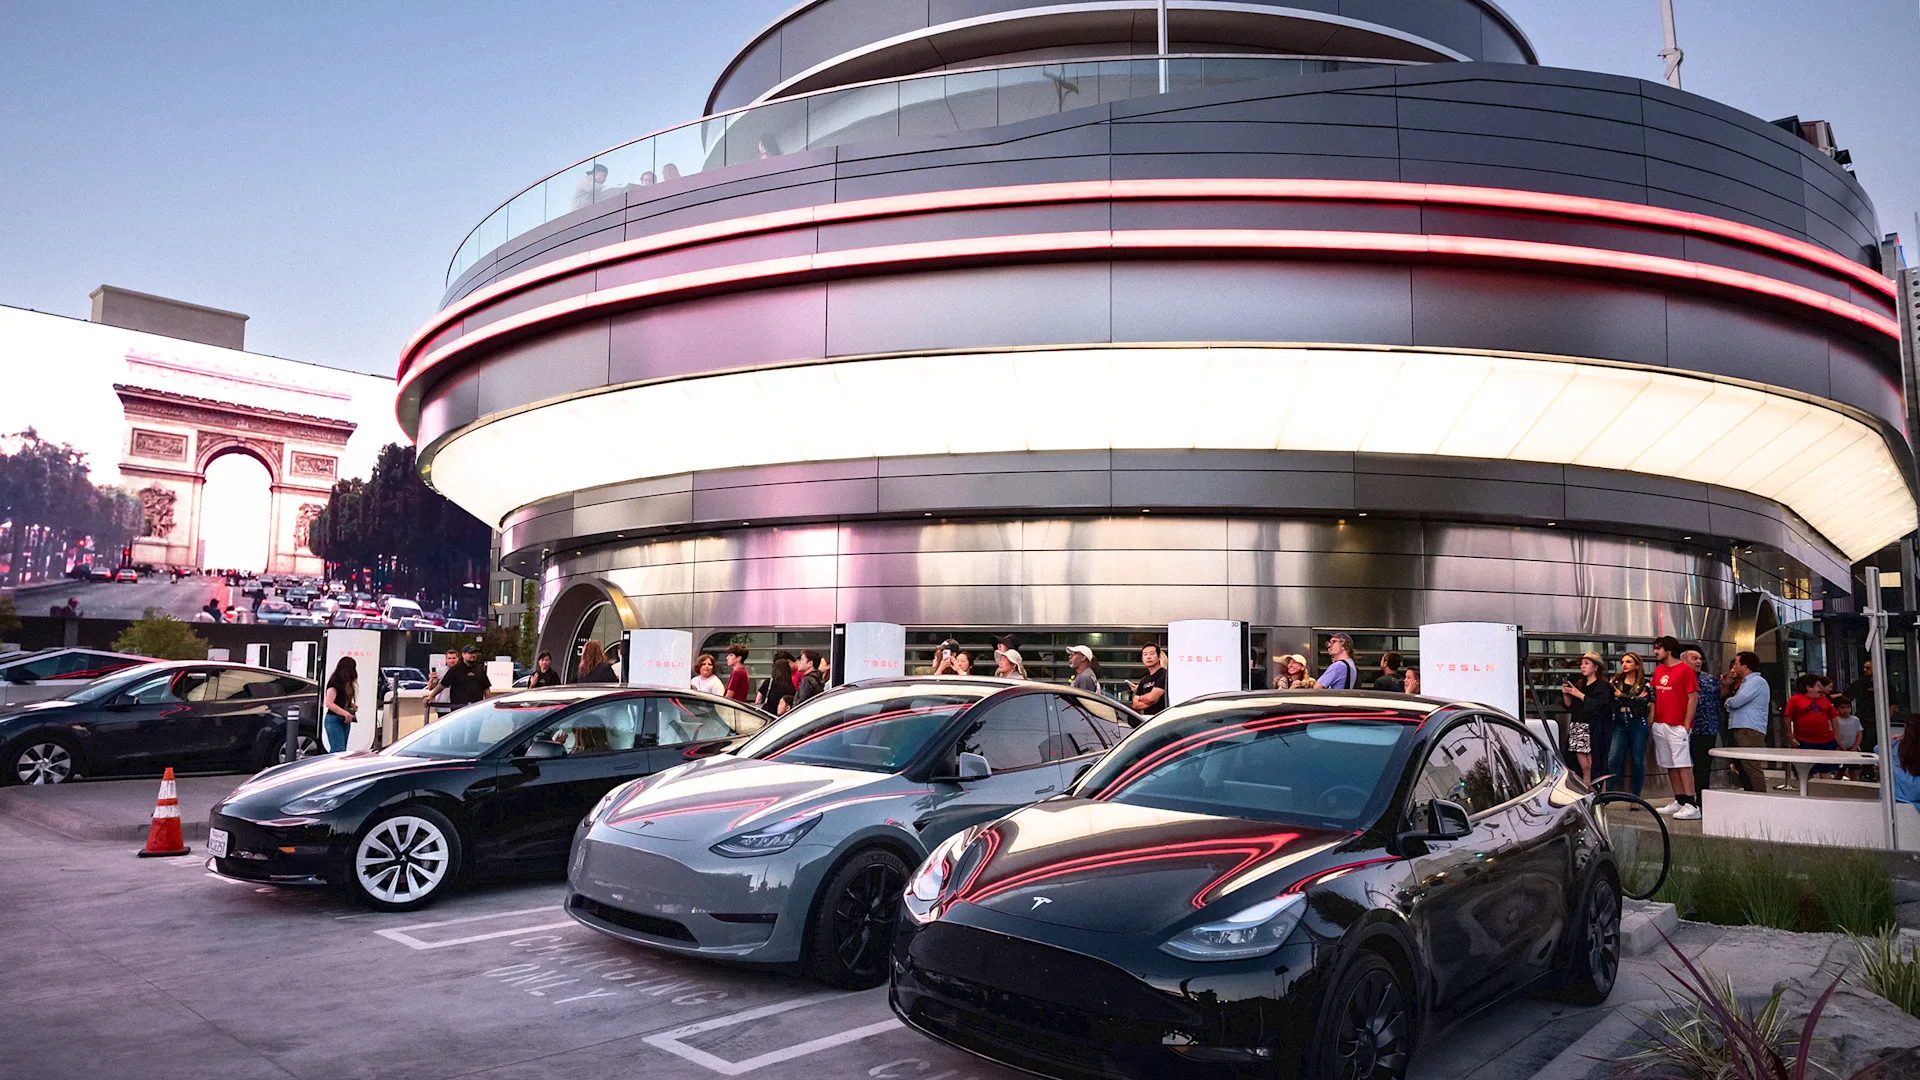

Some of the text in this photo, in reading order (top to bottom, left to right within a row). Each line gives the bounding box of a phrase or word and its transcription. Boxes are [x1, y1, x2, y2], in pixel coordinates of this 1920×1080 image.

[1436, 664, 1496, 672] TESLA
[482, 963, 618, 1005] ONLY
[508, 935, 729, 1006] CHARGING
